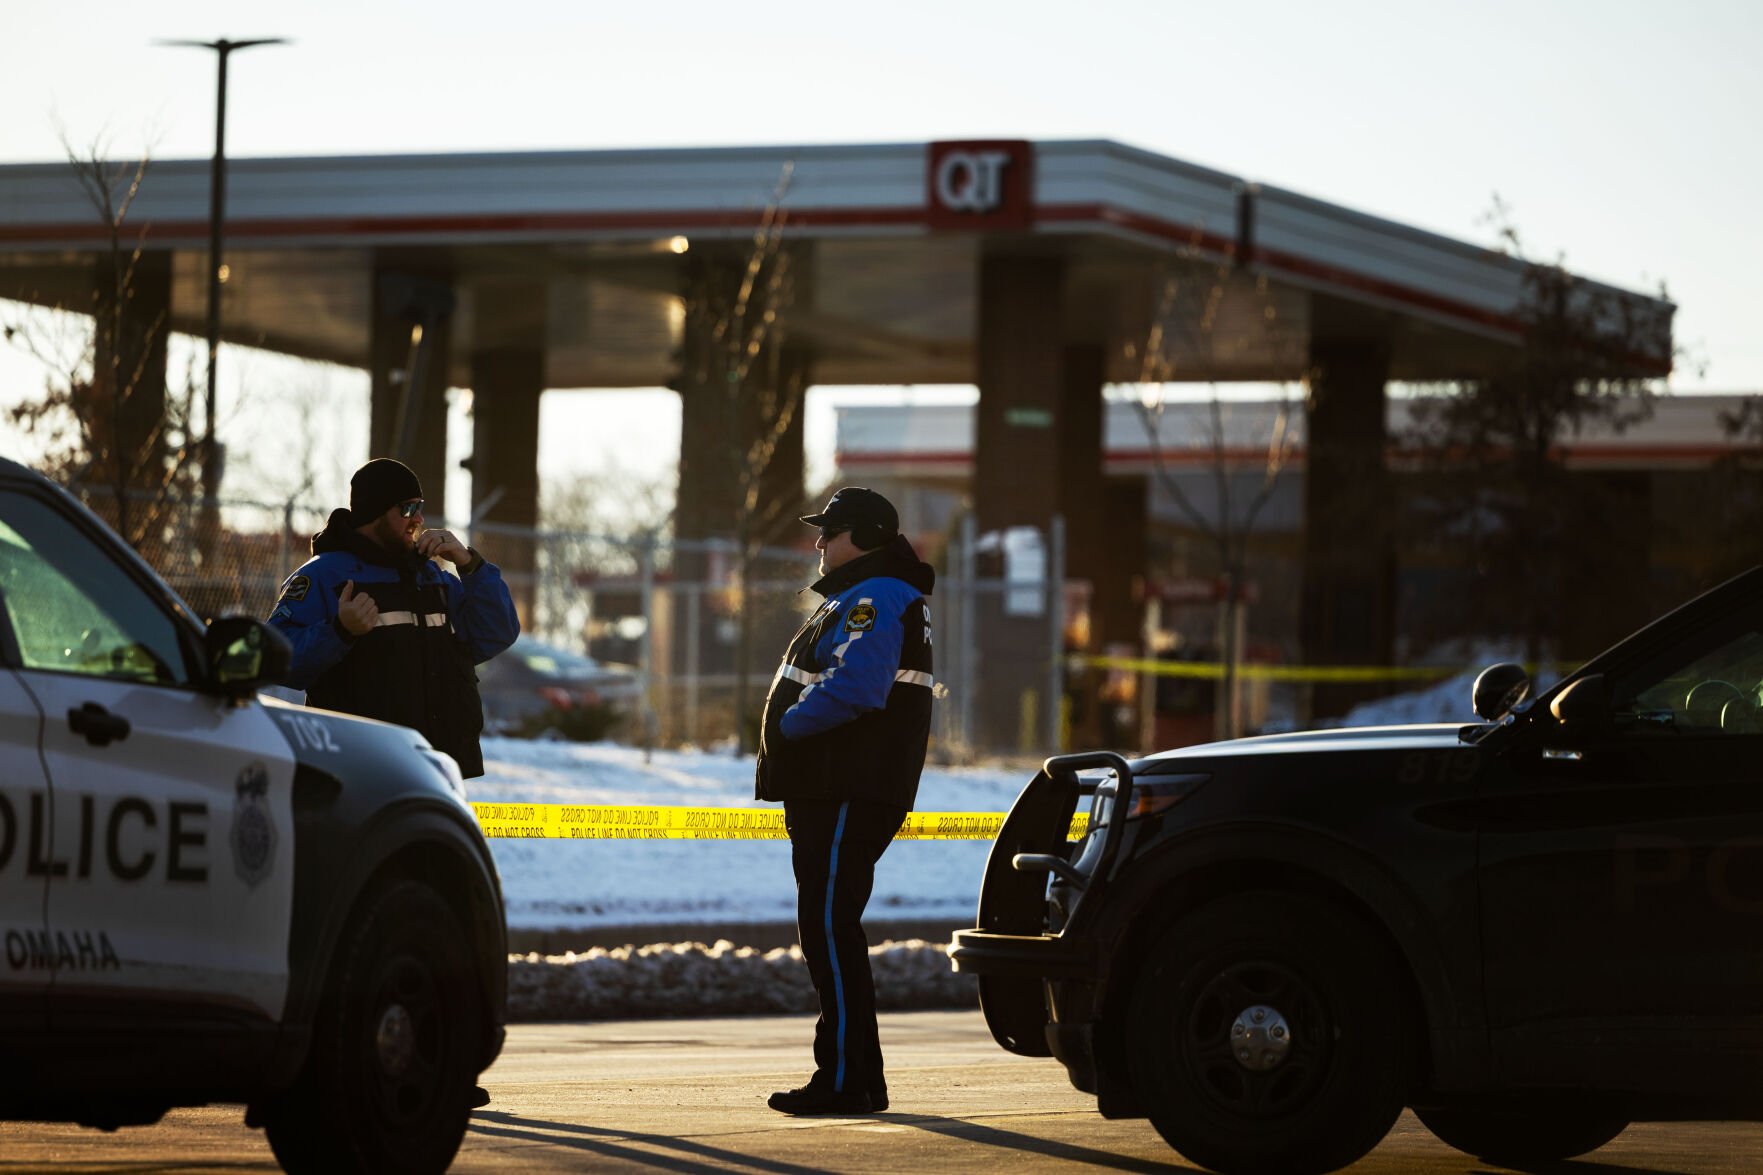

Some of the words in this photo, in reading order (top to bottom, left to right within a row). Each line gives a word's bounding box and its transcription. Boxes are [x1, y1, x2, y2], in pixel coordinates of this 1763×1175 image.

[938, 151, 1011, 209] QT
[282, 714, 340, 752] 702
[6, 930, 120, 970] OMAHA
